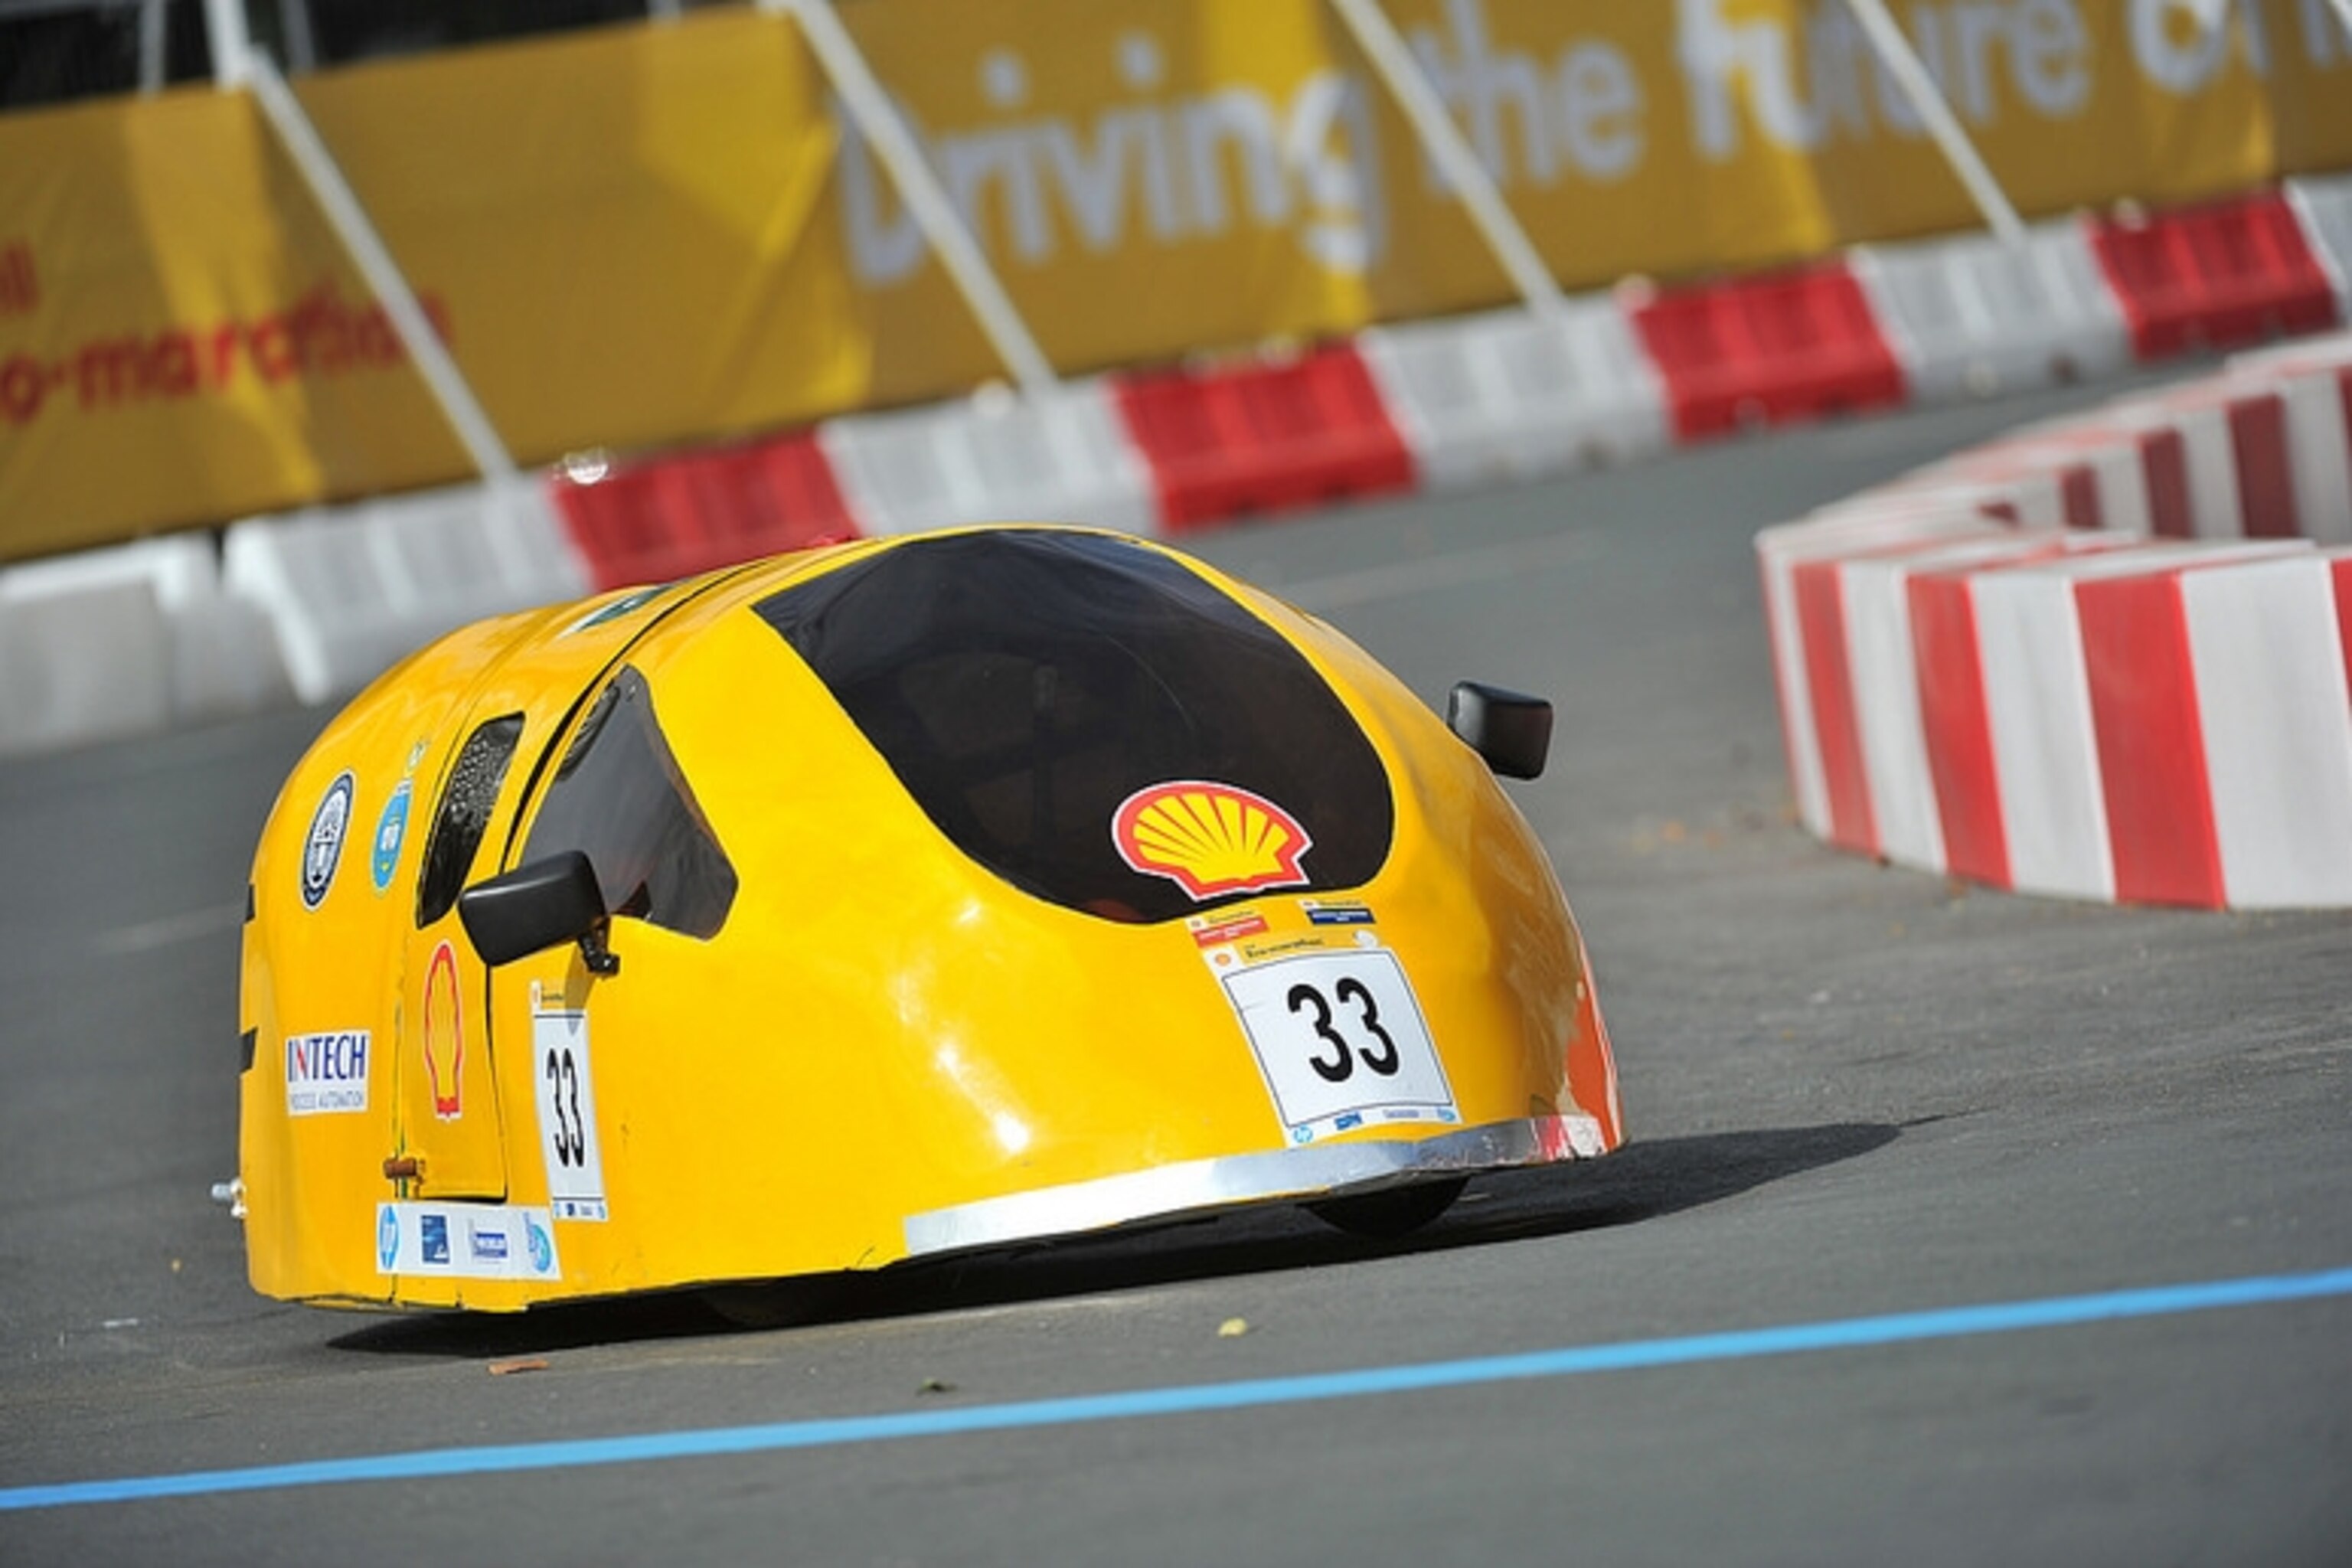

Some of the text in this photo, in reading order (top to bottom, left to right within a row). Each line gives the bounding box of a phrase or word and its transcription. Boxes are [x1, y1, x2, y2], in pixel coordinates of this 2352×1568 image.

[1409, 0, 1645, 199] the
[288, 1034, 366, 1083] INTECH
[1286, 976, 1400, 1083] 33
[546, 1047, 585, 1168] 33
